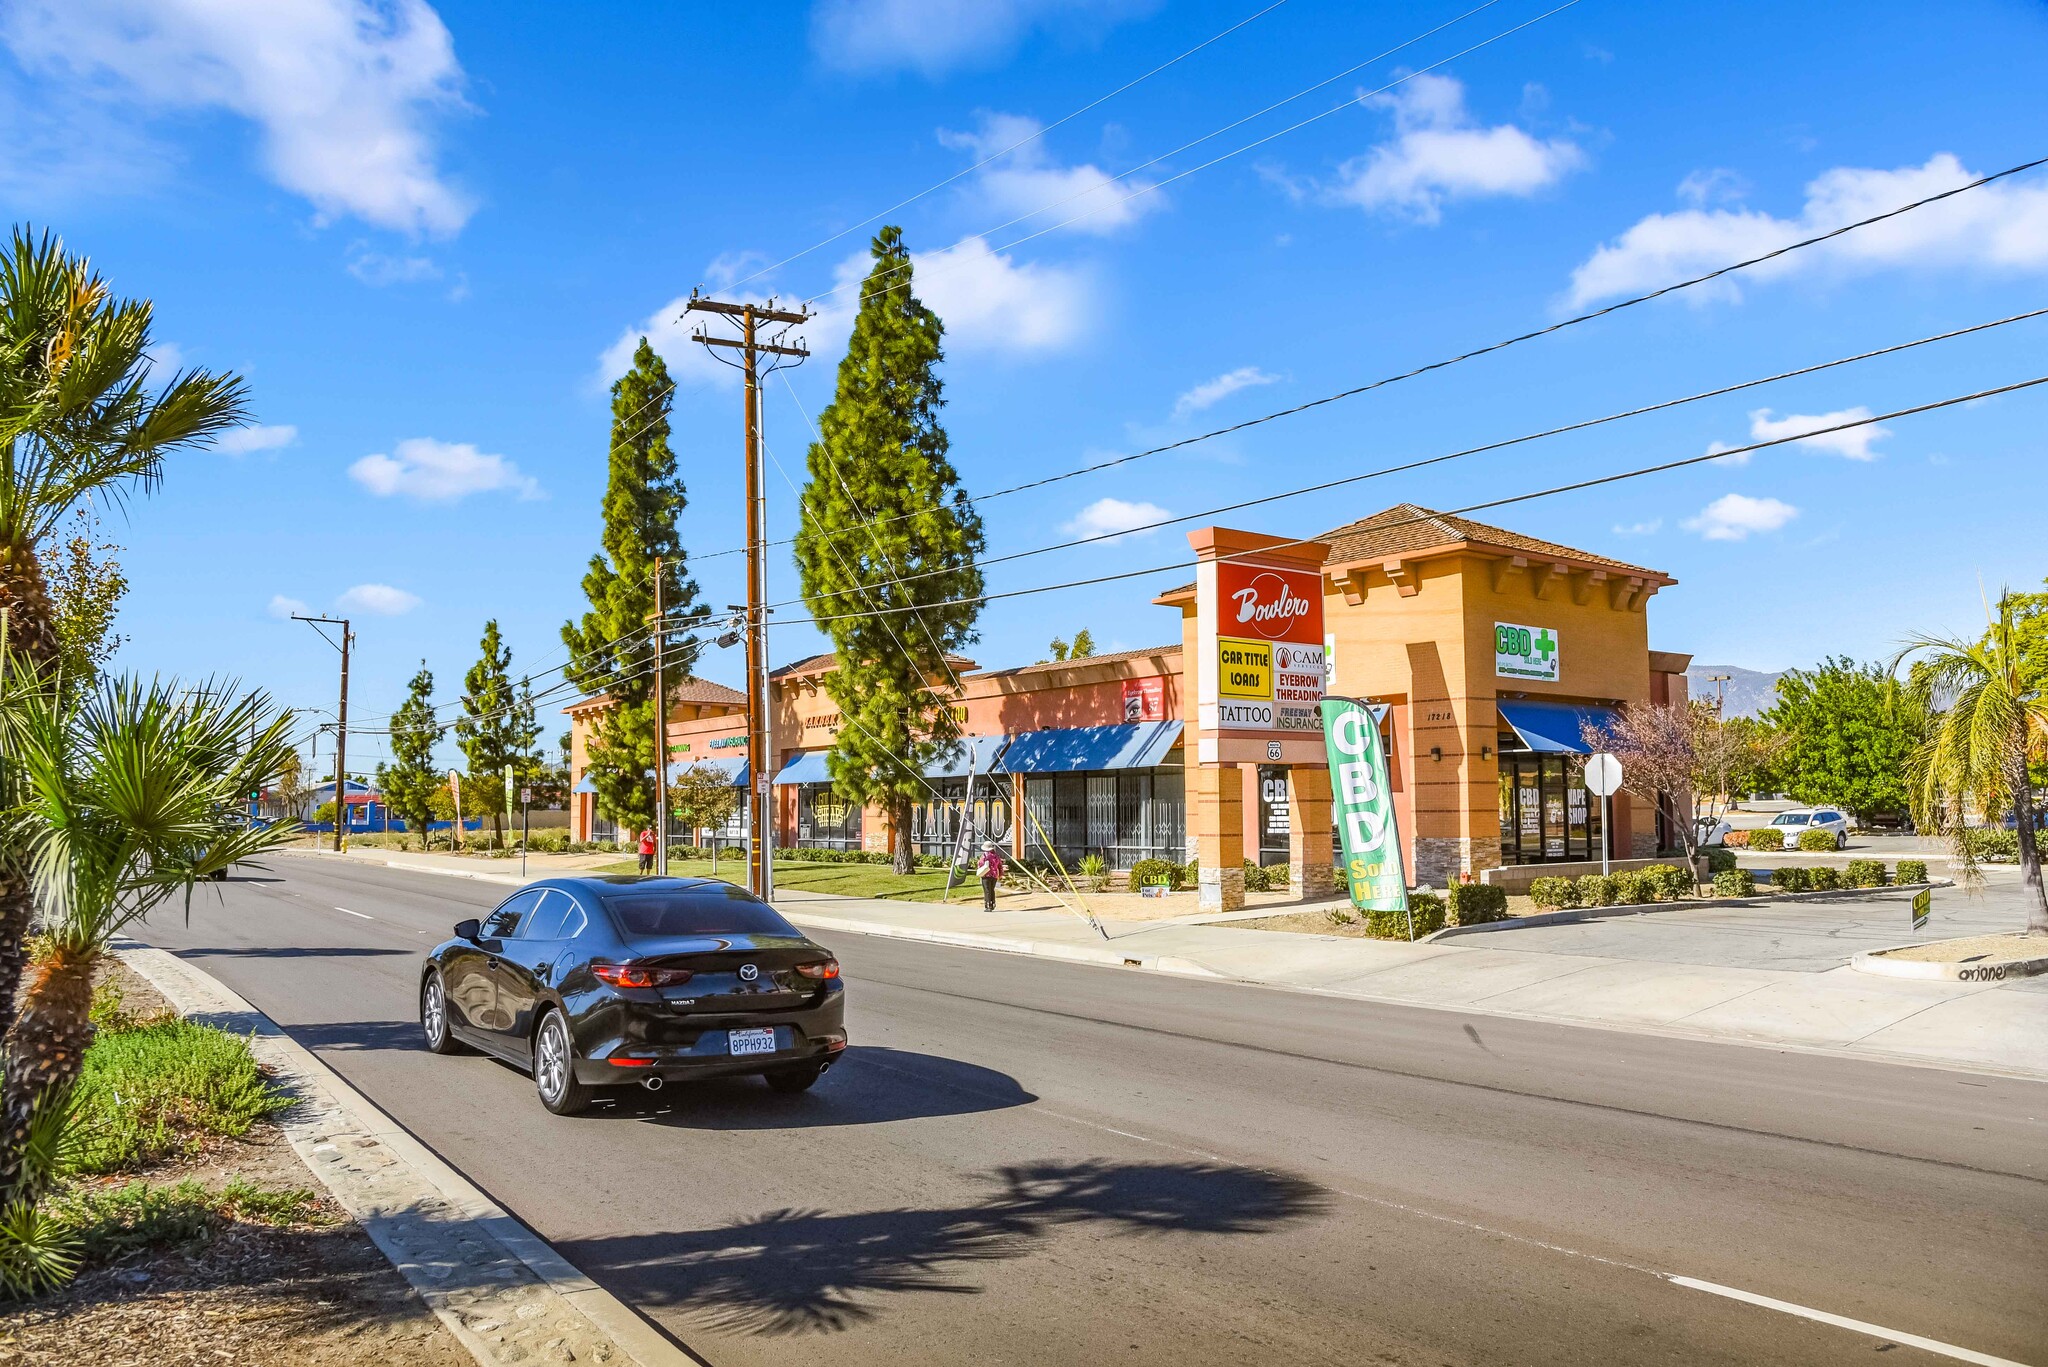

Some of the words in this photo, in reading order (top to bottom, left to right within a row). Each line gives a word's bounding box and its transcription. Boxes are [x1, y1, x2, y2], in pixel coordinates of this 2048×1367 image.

[1232, 584, 1309, 623] Bowlero
[1496, 625, 1531, 656] CBD
[1221, 650, 1242, 665] CAR
[1245, 650, 1269, 667] TITLE
[1293, 650, 1323, 665] CAM
[1230, 672, 1260, 688] LOANS
[1279, 673, 1319, 688] EYEBROW
[1276, 688, 1323, 701] THREADING
[1219, 705, 1272, 723] TATTOO
[1280, 707, 1312, 717] FREEWAY
[1427, 712, 1451, 721] 17218
[1276, 717, 1323, 730] INSURANCE
[1270, 749, 1279, 757] 66
[1332, 711, 1385, 854] CBD
[1520, 787, 1540, 805] CBD
[1567, 788, 1586, 805] VAPE
[1568, 807, 1588, 825] SHOP
[1142, 875, 1167, 885] CBD
[1913, 889, 1930, 910] CBD
[732, 1037, 774, 1052] 8PPH932
